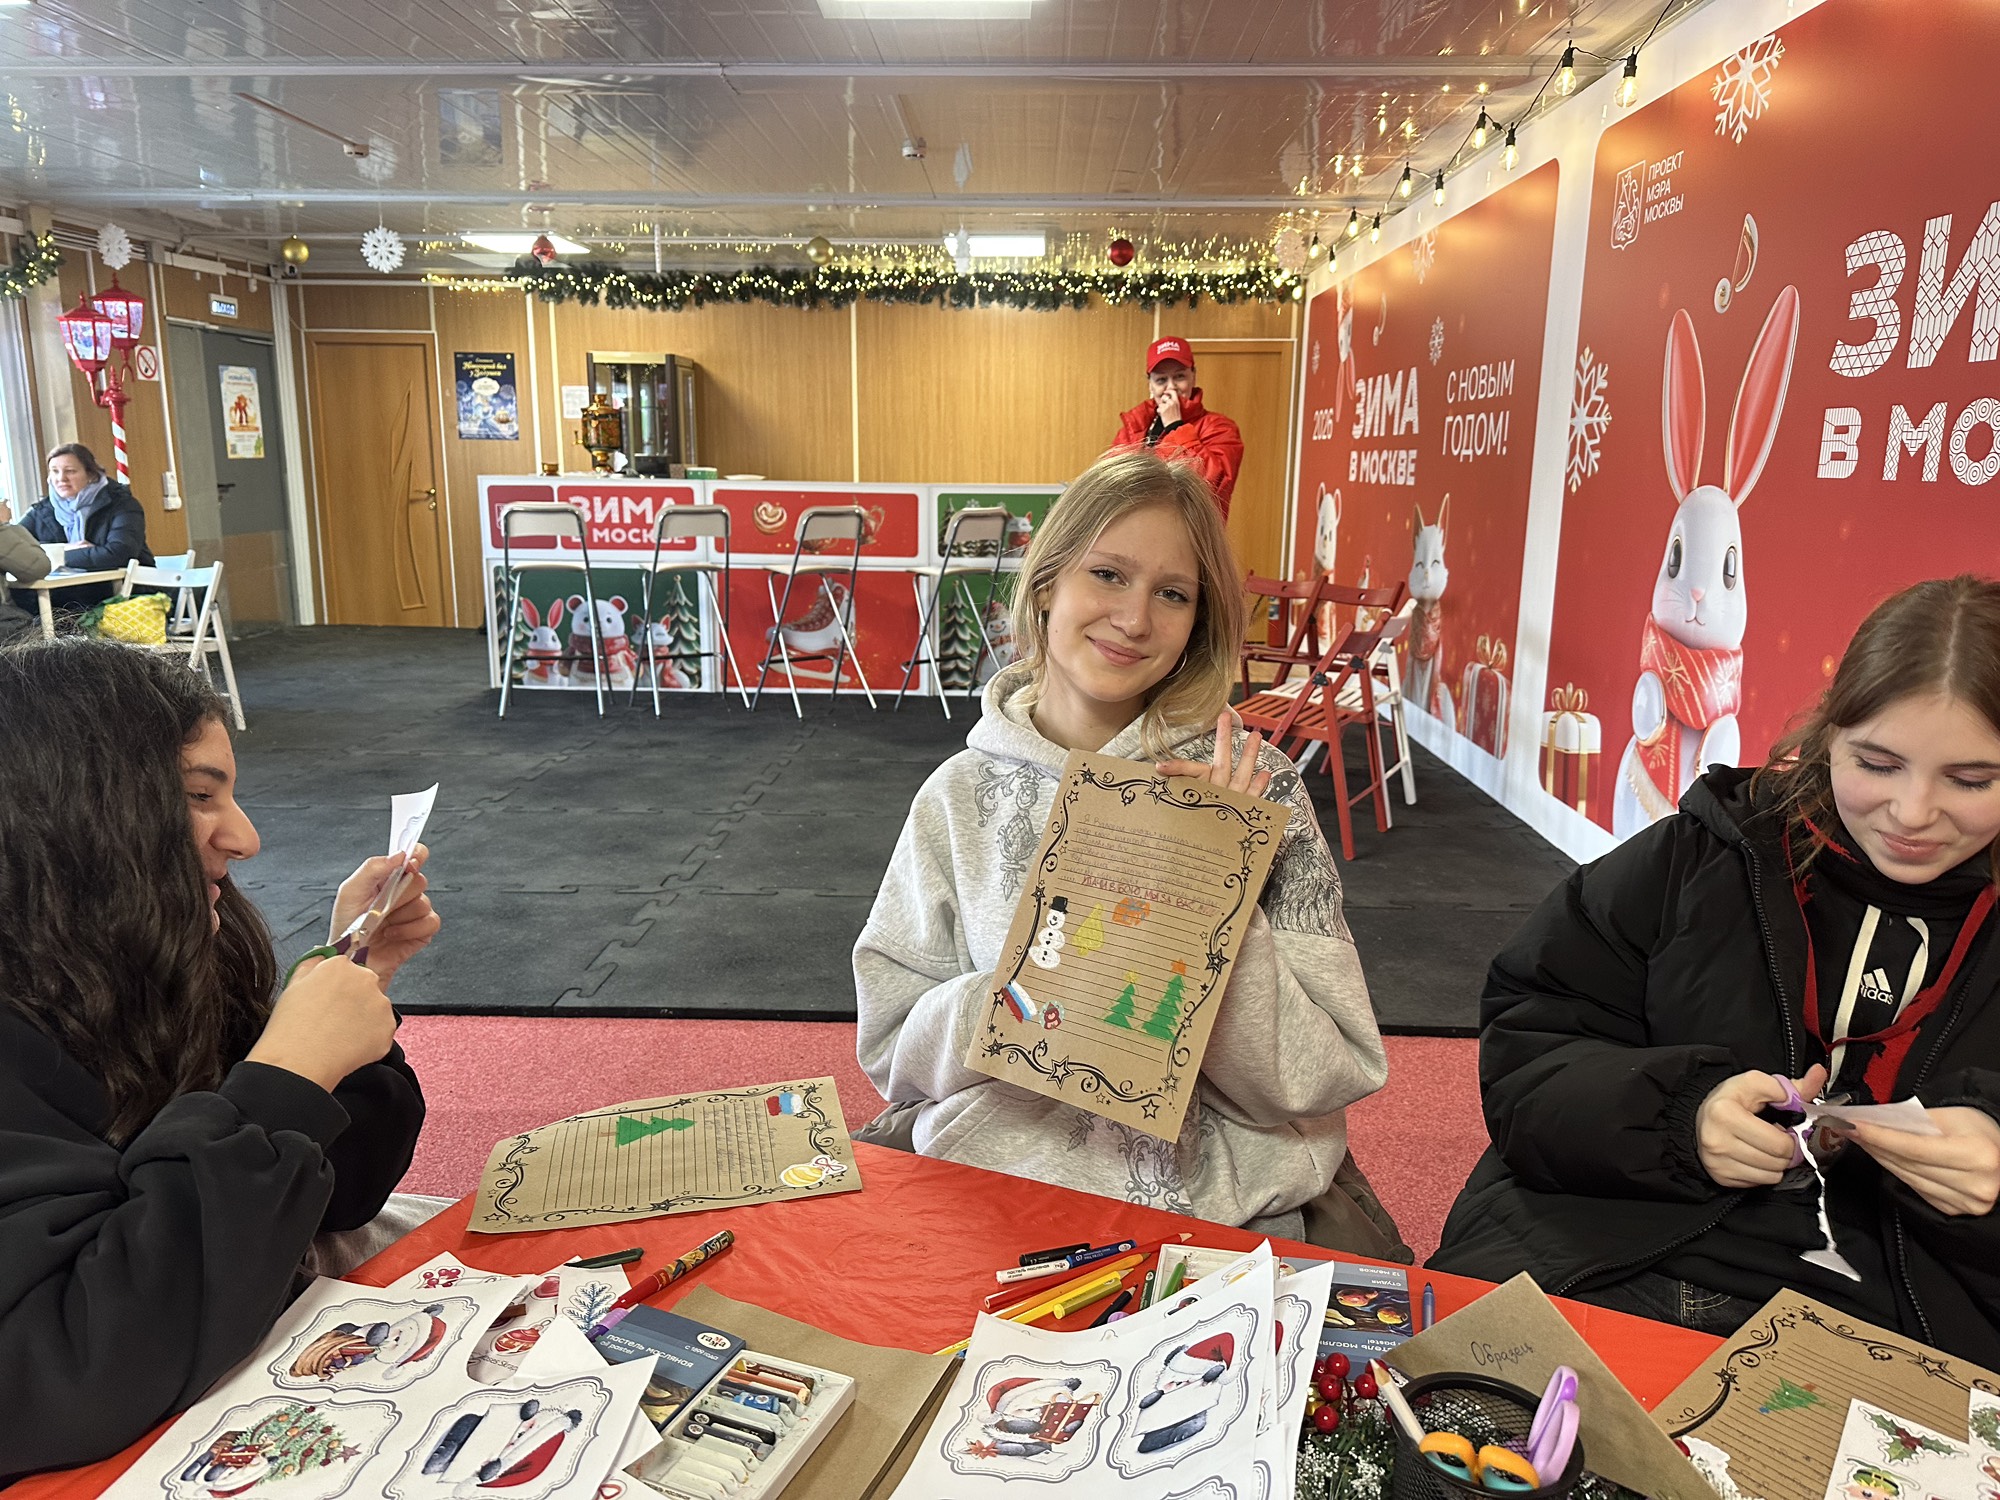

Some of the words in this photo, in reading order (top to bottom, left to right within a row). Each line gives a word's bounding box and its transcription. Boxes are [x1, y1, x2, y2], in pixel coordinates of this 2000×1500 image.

[1648, 150, 1684, 182] ПРОЕКТ
[1646, 178, 1671, 203] МЭРА
[1644, 193, 1684, 225] МОСКВЫ
[1446, 370, 1457, 404] С
[1458, 359, 1515, 402] НОВЫМ
[1352, 367, 1419, 440] ЗИМА
[1312, 408, 1334, 440] 2026
[1442, 410, 1510, 463] ГОДОМ!
[1817, 406, 1862, 479] В
[1349, 451, 1358, 482] В
[1359, 449, 1418, 486] МОСКВЕ
[592, 528, 687, 544] МОСК
[1860, 985, 1894, 1005] idas
[1359, 1267, 1391, 1275] мелков
[606, 1334, 645, 1350] пастель
[645, 1347, 694, 1368] масляная
[608, 1344, 635, 1354] pastel
[1471, 1341, 1534, 1371] Образец
